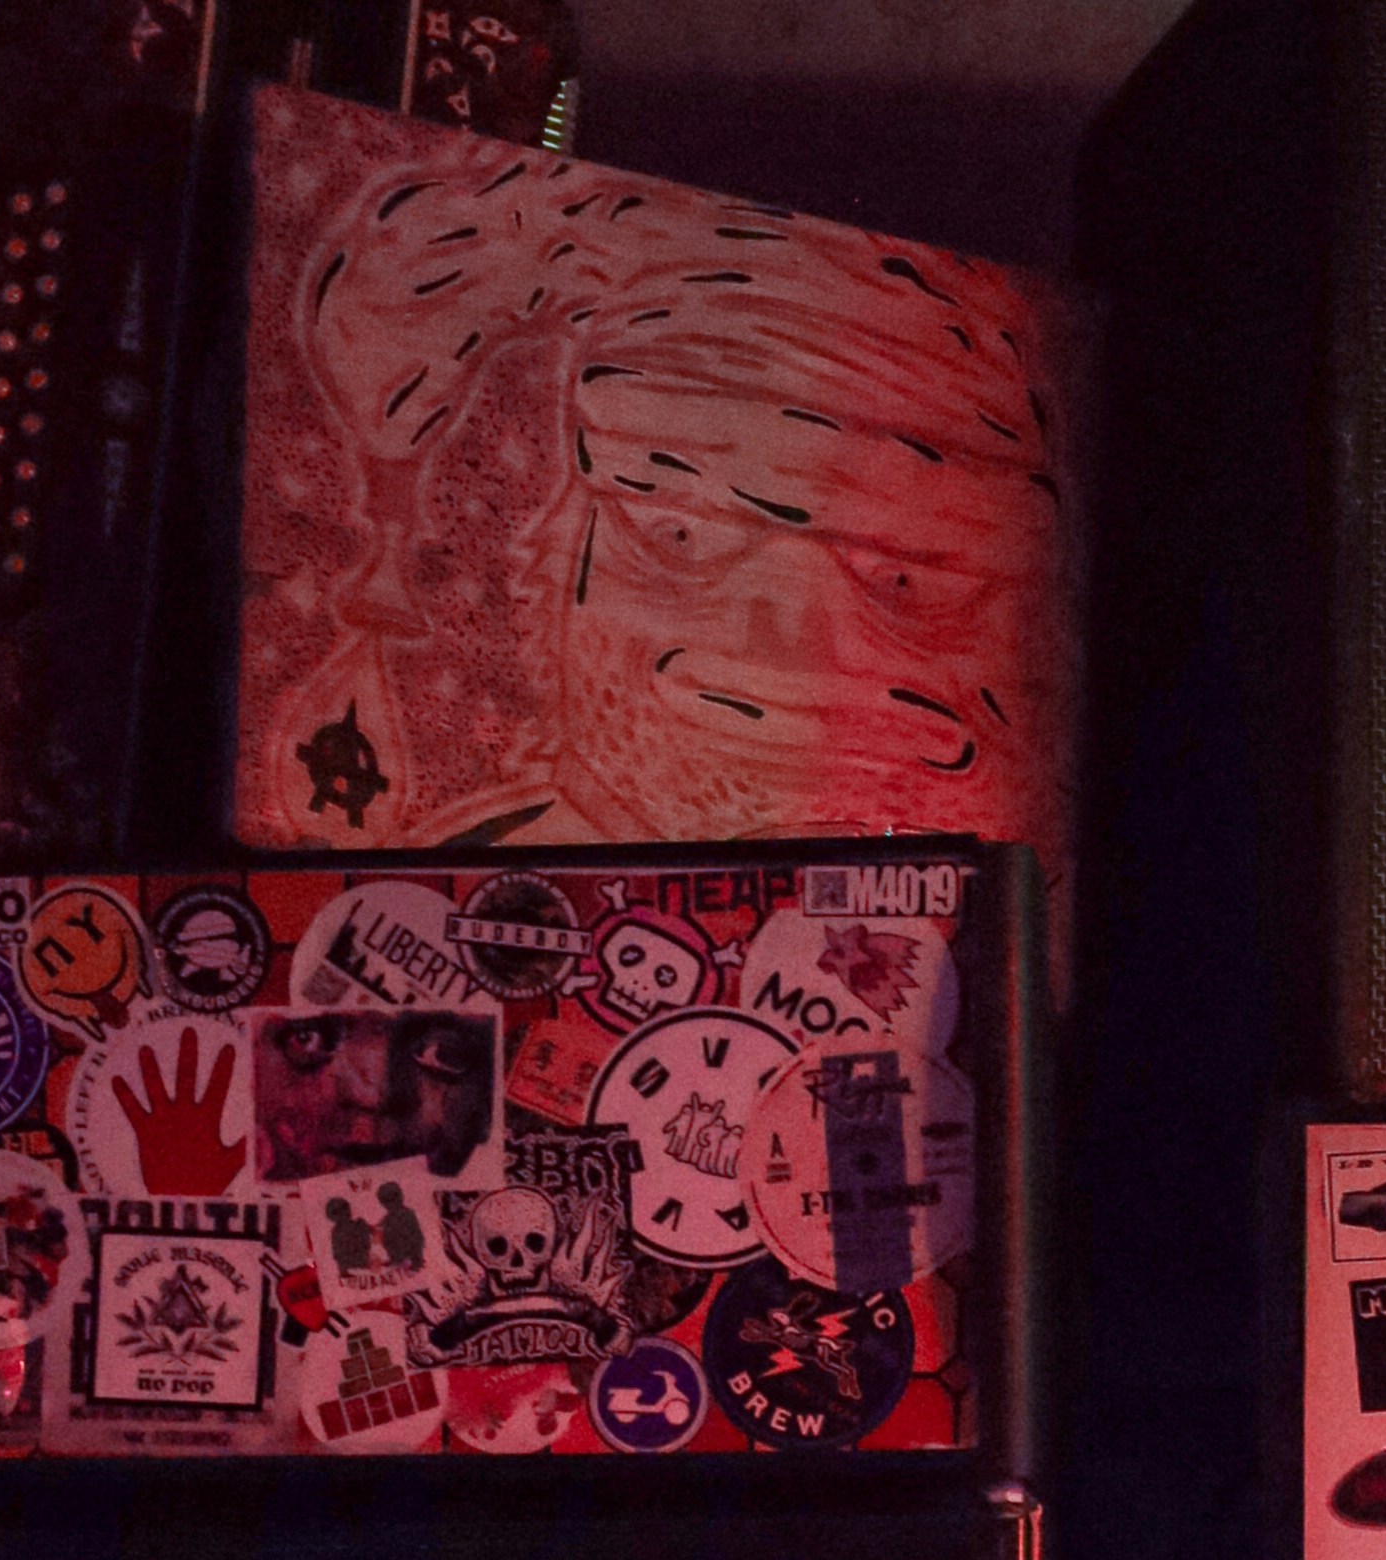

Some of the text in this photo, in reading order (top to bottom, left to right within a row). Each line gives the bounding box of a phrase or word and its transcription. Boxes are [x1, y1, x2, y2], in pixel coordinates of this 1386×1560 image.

[849, 864, 959, 915] M4019
[363, 912, 485, 1002] LIBERTY
[449, 918, 591, 952] RUDEBOY
[726, 1369, 827, 1438] BREW
